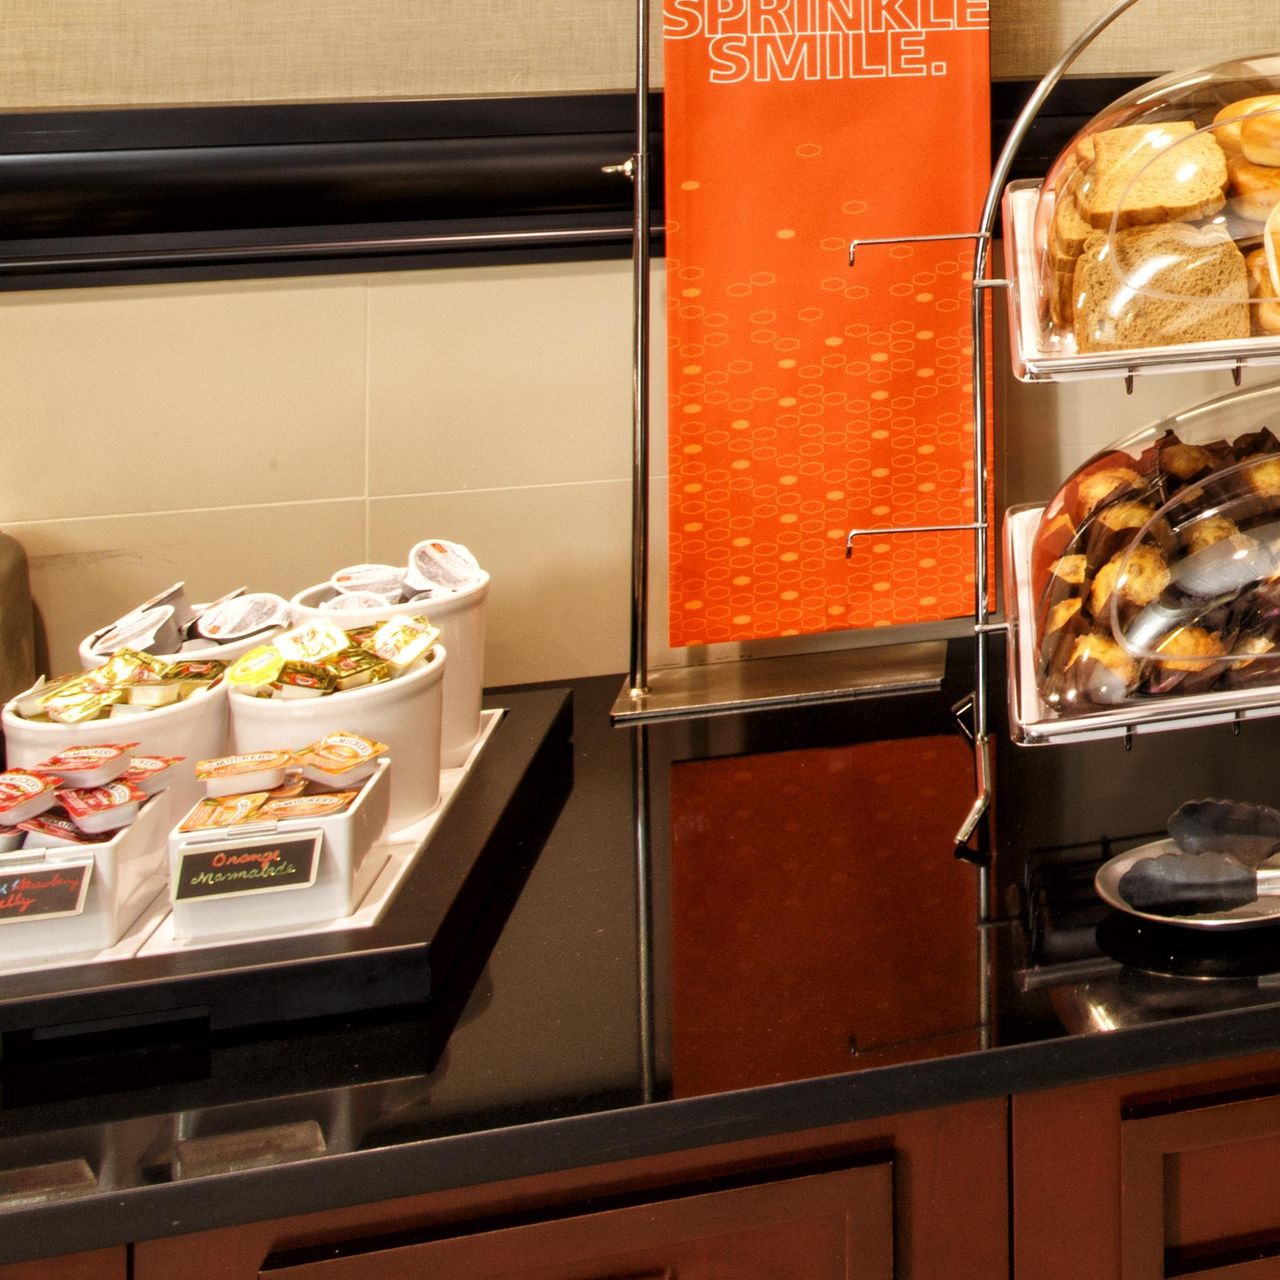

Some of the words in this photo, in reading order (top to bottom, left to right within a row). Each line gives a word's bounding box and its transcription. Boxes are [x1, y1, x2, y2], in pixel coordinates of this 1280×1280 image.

[708, 30, 948, 83] SMILE.
[212, 849, 281, 869] Orange
[190, 861, 297, 885] Marmalade
